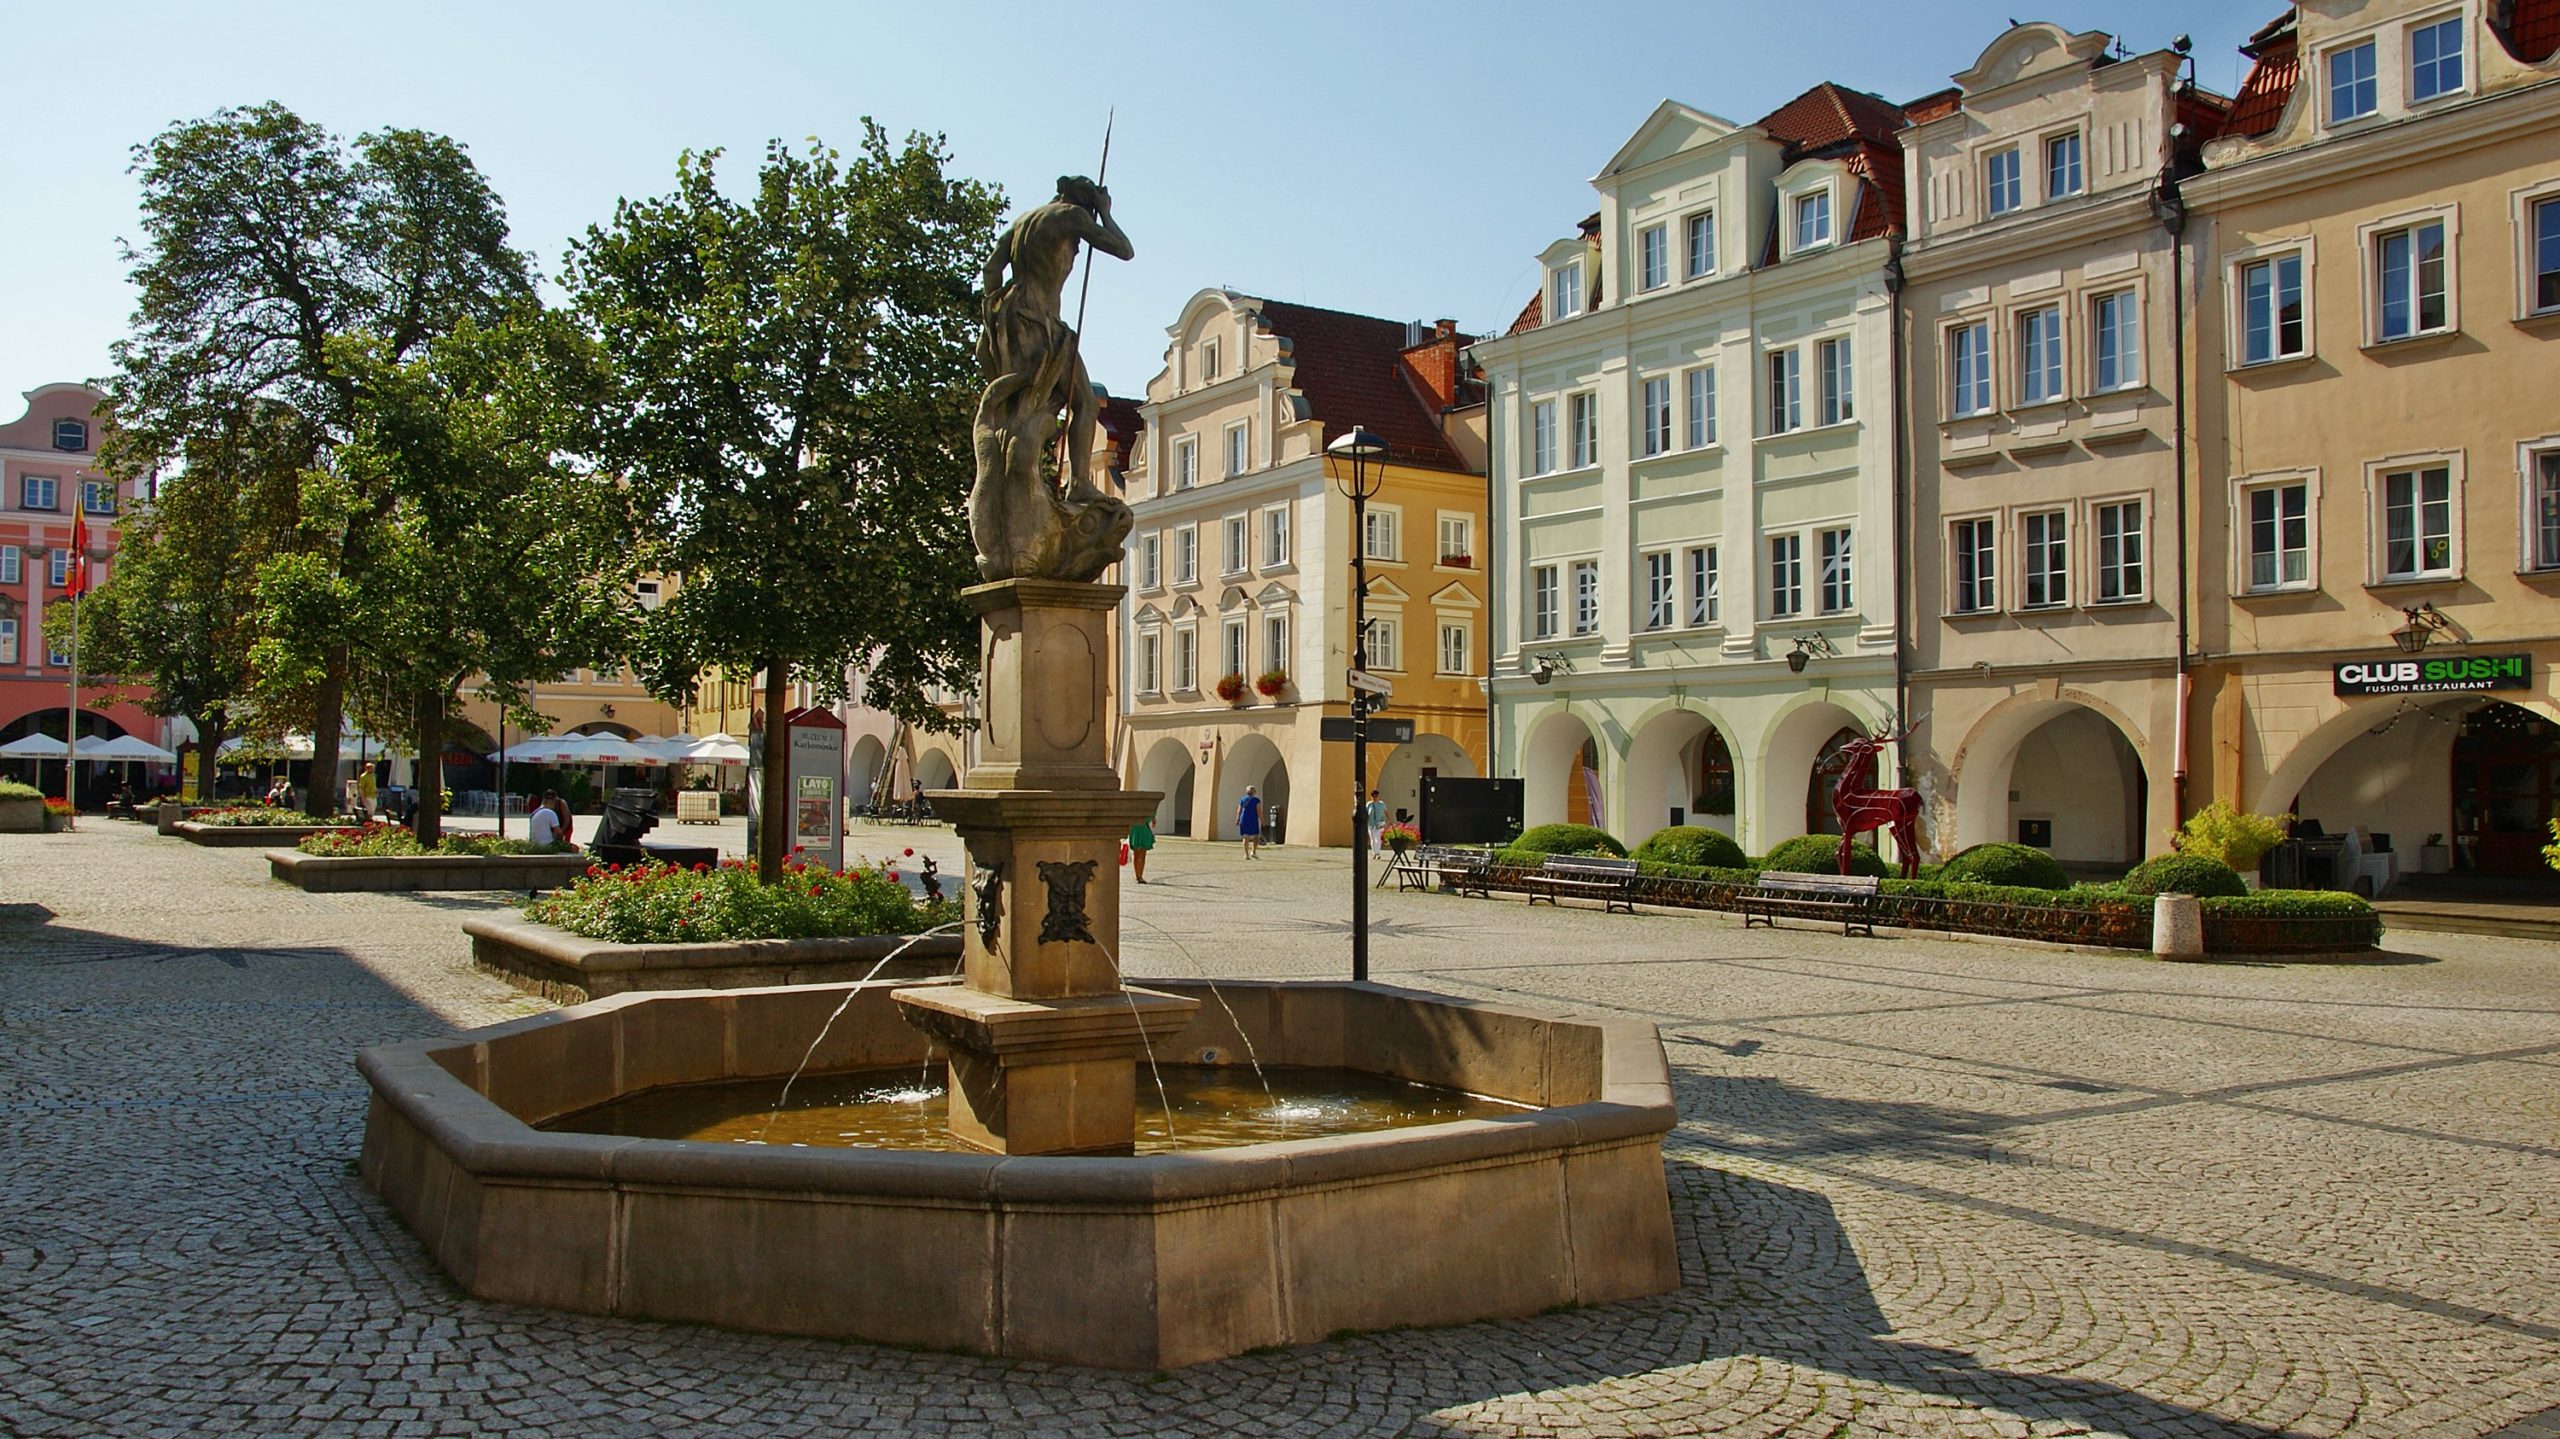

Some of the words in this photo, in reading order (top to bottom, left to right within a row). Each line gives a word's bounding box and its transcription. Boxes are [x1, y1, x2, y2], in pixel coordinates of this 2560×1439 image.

[2339, 661, 2419, 684] CLUB
[2424, 657, 2522, 680] SUSHI
[2364, 683, 2409, 693] FUSION
[2412, 680, 2494, 692] RESTAURANT
[803, 778, 828, 789] LATO
